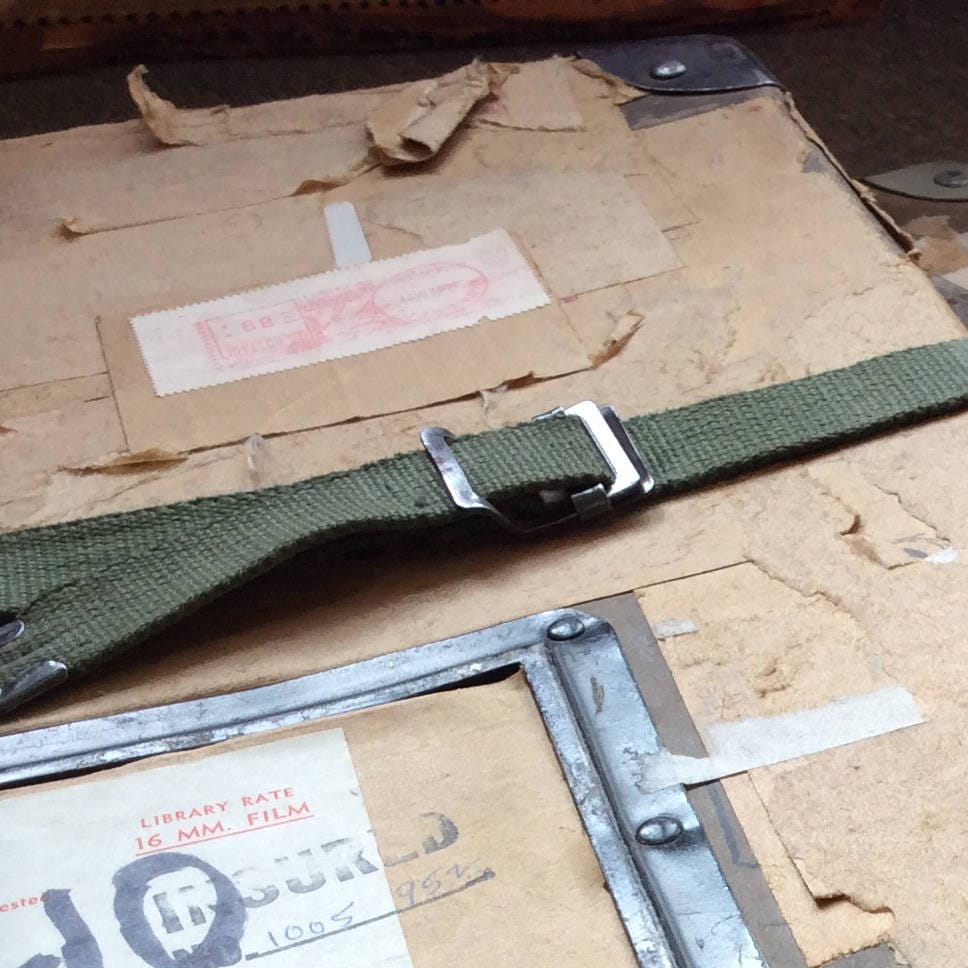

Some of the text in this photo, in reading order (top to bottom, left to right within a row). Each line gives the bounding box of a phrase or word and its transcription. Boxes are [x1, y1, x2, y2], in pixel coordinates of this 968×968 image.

[136, 801, 311, 850] 16 MM. FILM
[140, 787, 295, 829] LIBRARY RATE
